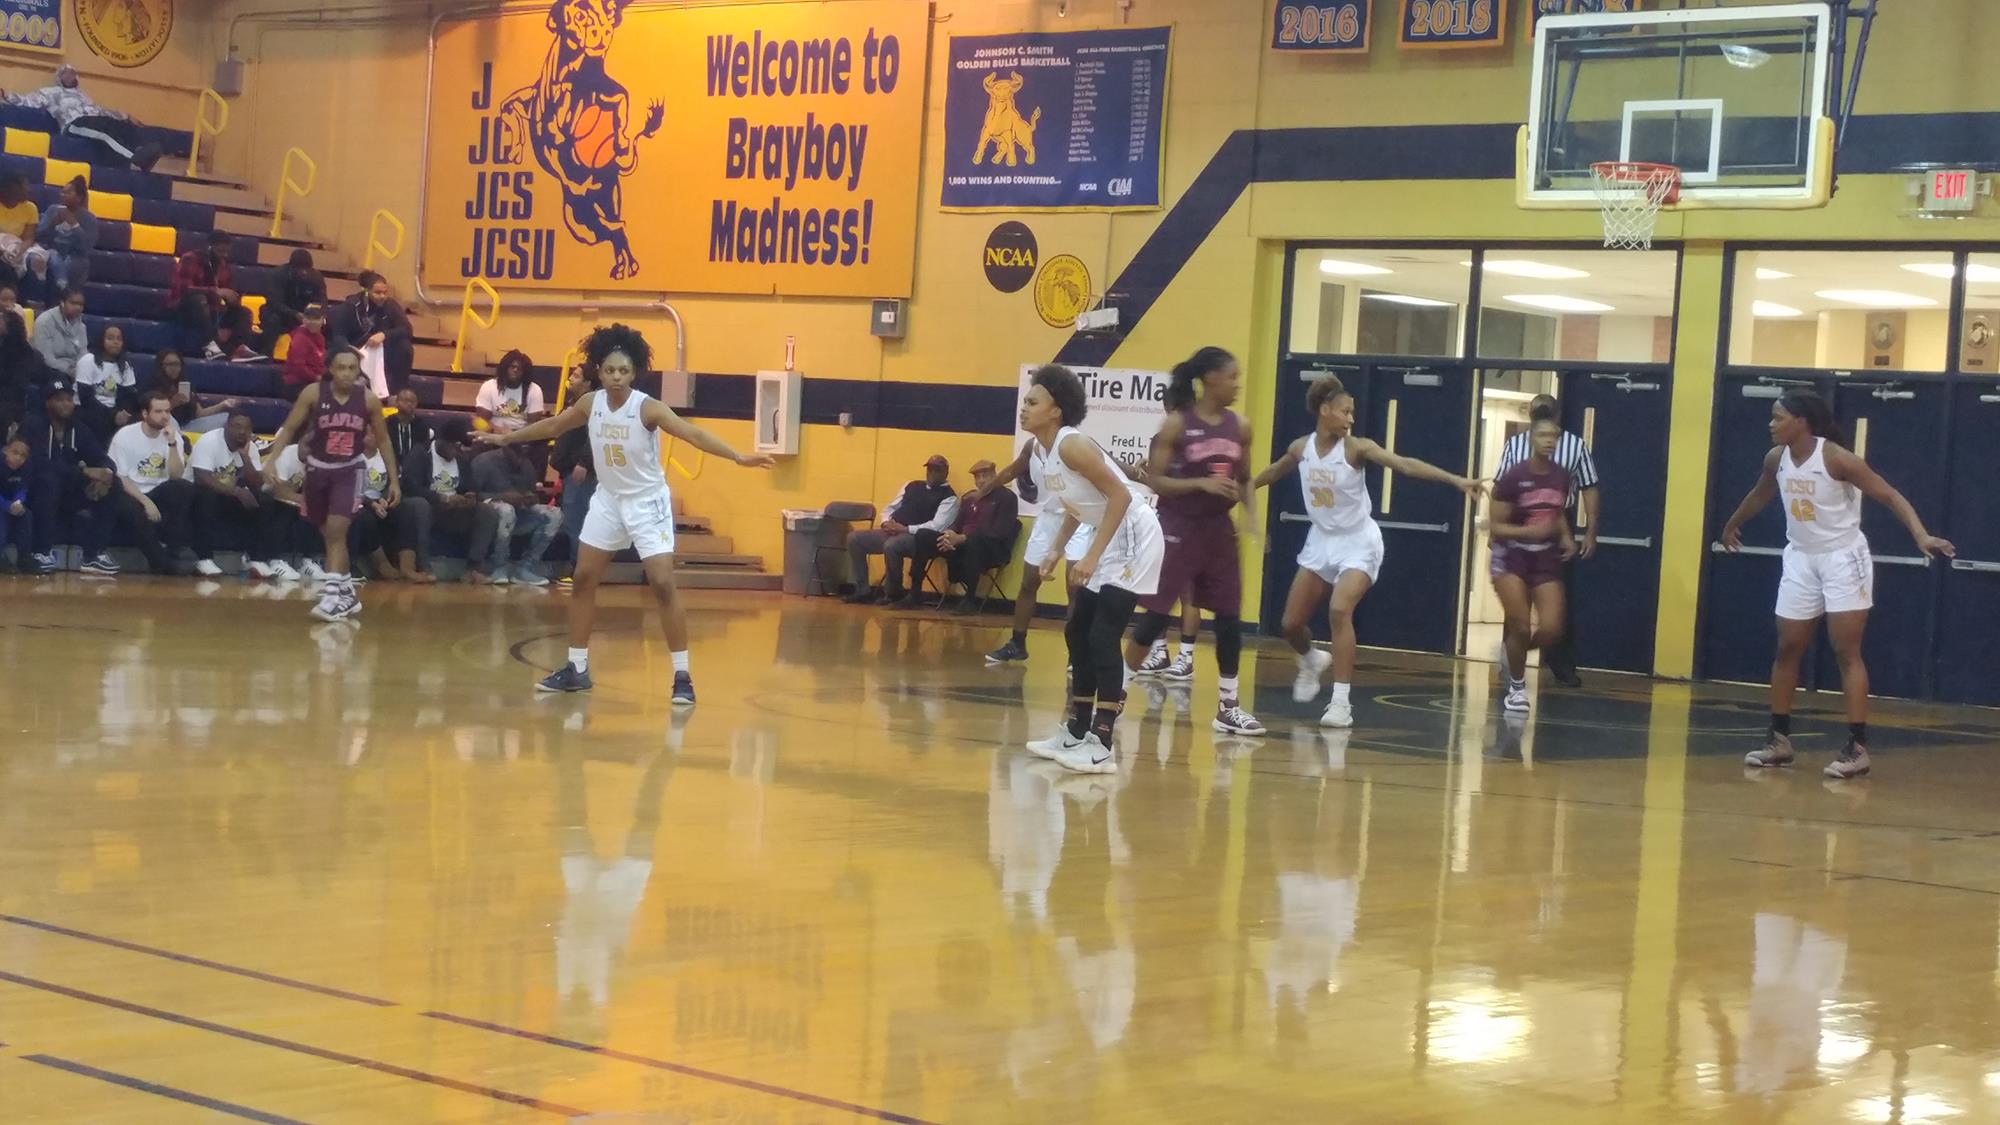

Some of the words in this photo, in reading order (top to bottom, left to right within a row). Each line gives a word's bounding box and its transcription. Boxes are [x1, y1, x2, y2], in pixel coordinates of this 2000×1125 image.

[1280, 4, 1358, 43] 2016
[1411, 0, 1491, 36] 2018
[706, 31, 851, 97] Welcome
[863, 27, 899, 95] to
[956, 59, 991, 69] GOLDEN
[992, 58, 1019, 68] BULLS
[1020, 57, 1071, 66] BASKETBALL
[974, 48, 1016, 58] JOHNSON
[1026, 46, 1054, 55] SMITH
[472, 62, 491, 109] J
[726, 112, 868, 192] Brayboy
[968, 176, 992, 185] WINS
[993, 176, 1012, 184] AND
[1079, 183, 1098, 191] NCAA
[1935, 173, 1967, 198] EXIT
[465, 171, 533, 220] JCS
[709, 197, 874, 265] Madness!
[461, 227, 555, 280] JCSU
[986, 248, 1034, 267] NCAA
[1077, 372, 1123, 399] Tire
[596, 423, 630, 440] JCSU
[1111, 435, 1135, 447] Fred
[1137, 437, 1147, 448] L.
[603, 443, 626, 467] 15
